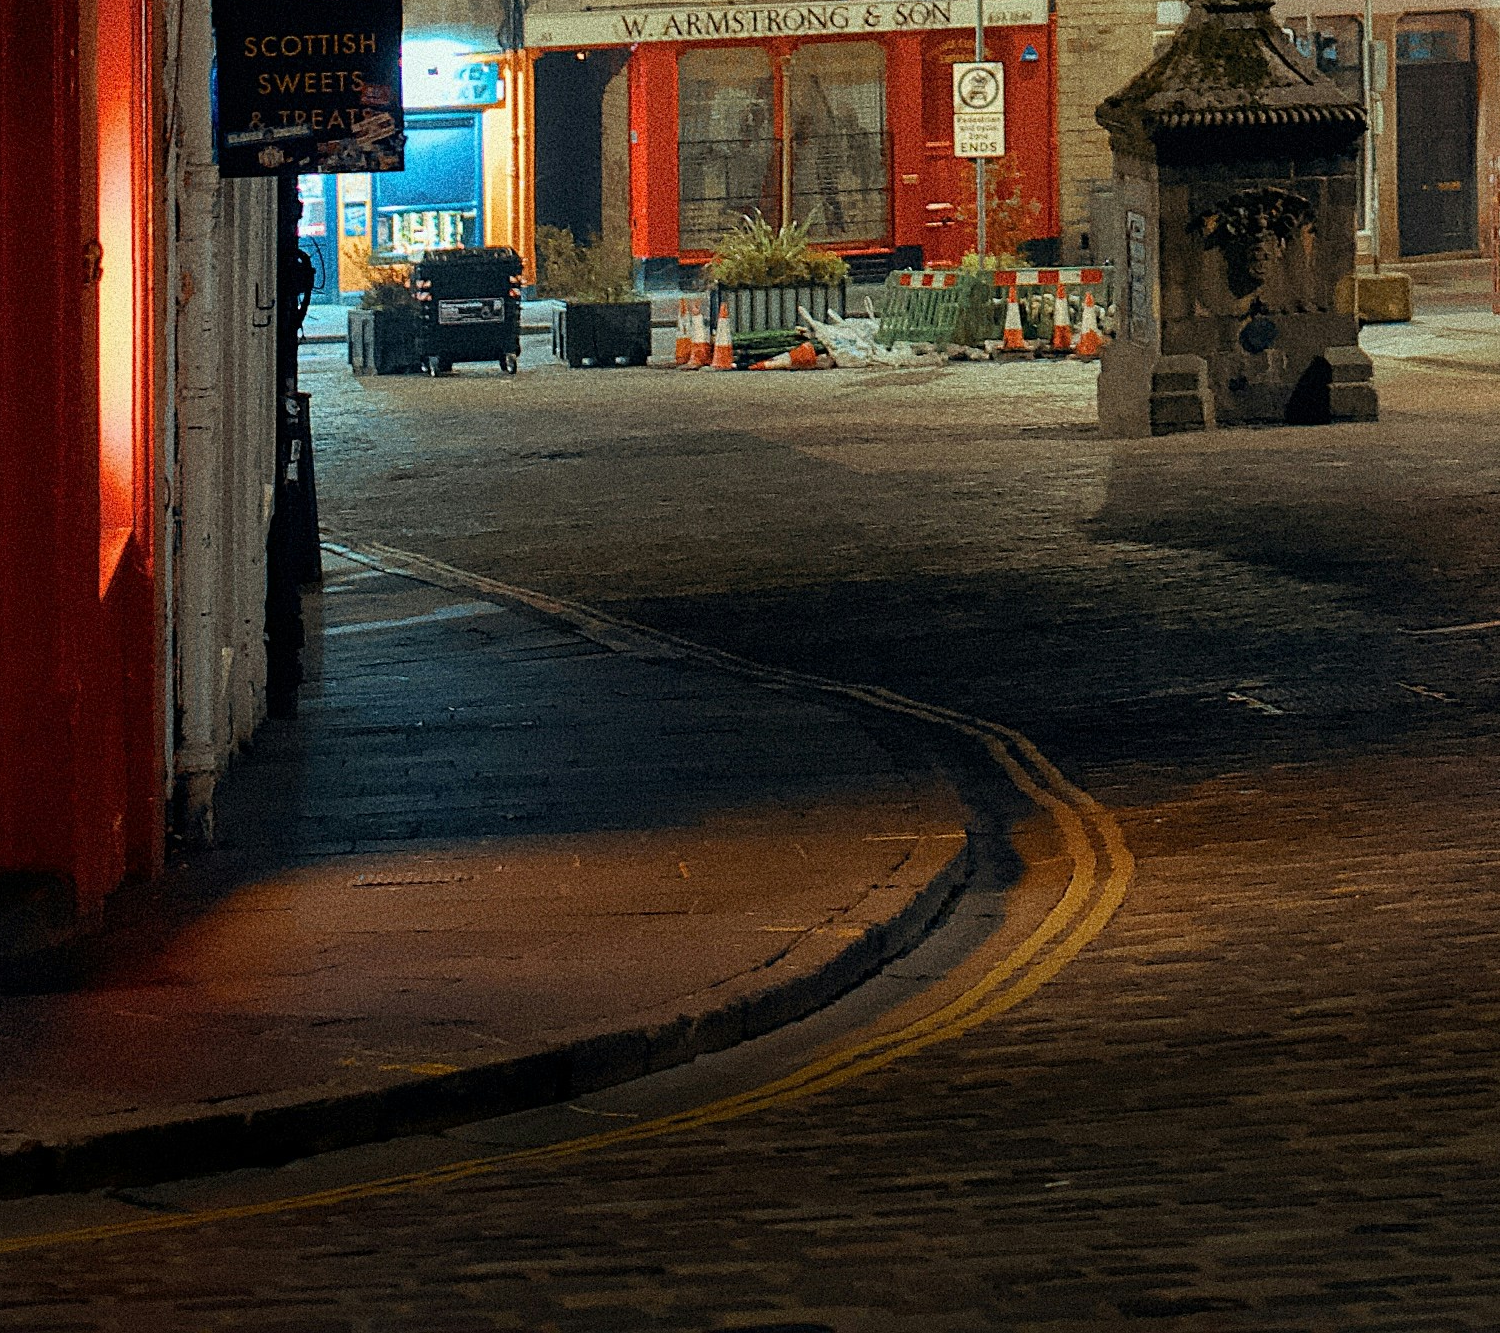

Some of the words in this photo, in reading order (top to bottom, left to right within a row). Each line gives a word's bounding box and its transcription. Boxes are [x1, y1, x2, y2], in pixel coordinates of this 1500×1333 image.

[620, 13, 654, 40] W.
[663, 4, 850, 37] ARMSTRONG
[863, 4, 881, 28] &
[892, 0, 951, 28] SON
[243, 32, 378, 58] SCOTTISH
[257, 70, 366, 95] SWEETS
[248, 110, 267, 131] &
[960, 141, 998, 153] ENDS
